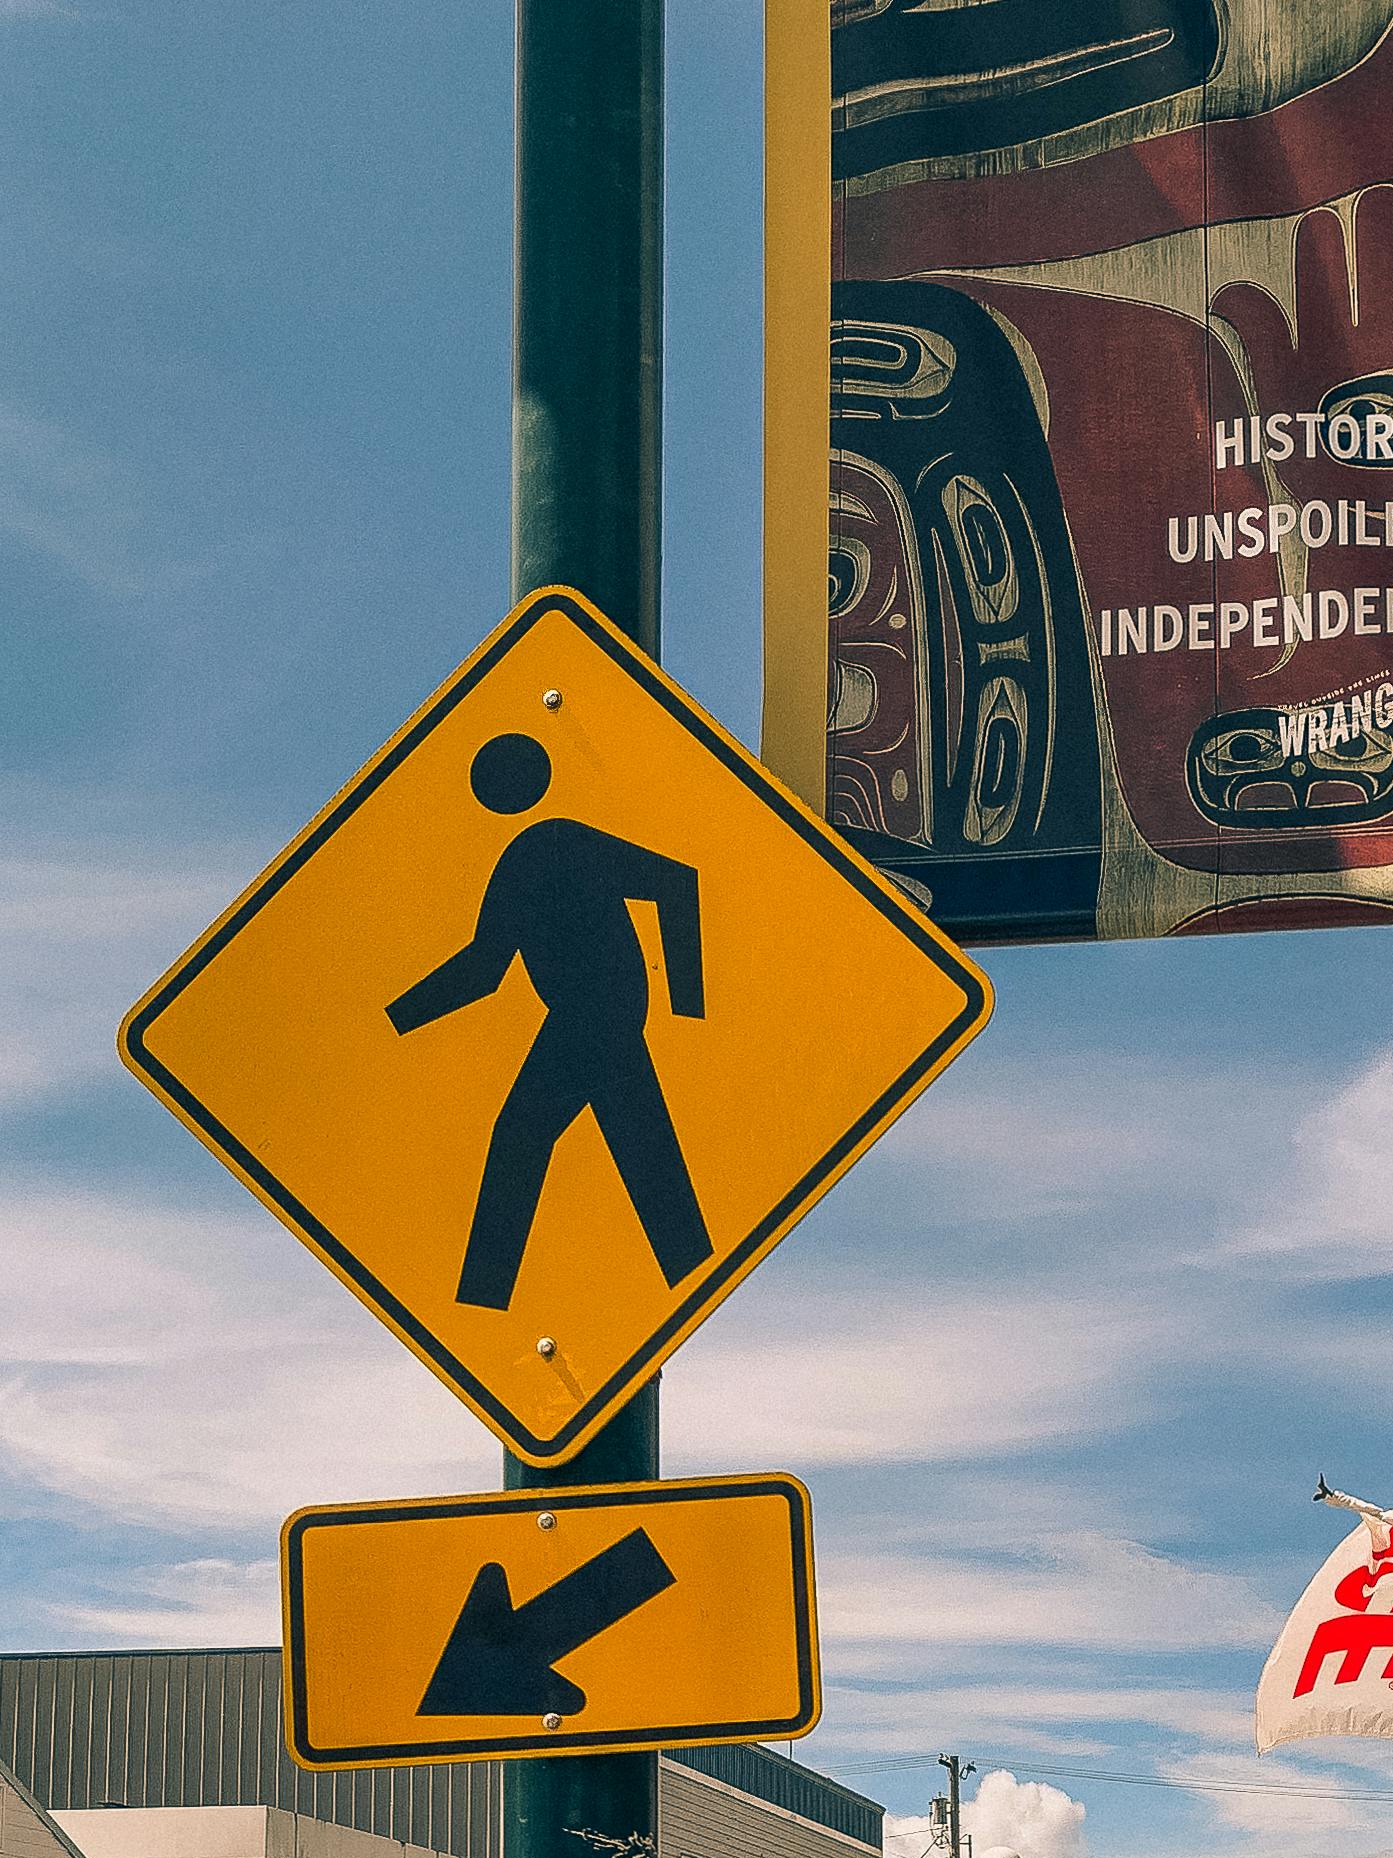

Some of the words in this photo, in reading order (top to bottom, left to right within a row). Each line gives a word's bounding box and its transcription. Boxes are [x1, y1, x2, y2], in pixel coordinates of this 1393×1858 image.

[1311, 688, 1345, 705] OUTSIDE
[1348, 680, 1363, 691] THE
[1366, 669, 1391, 683] LINES
